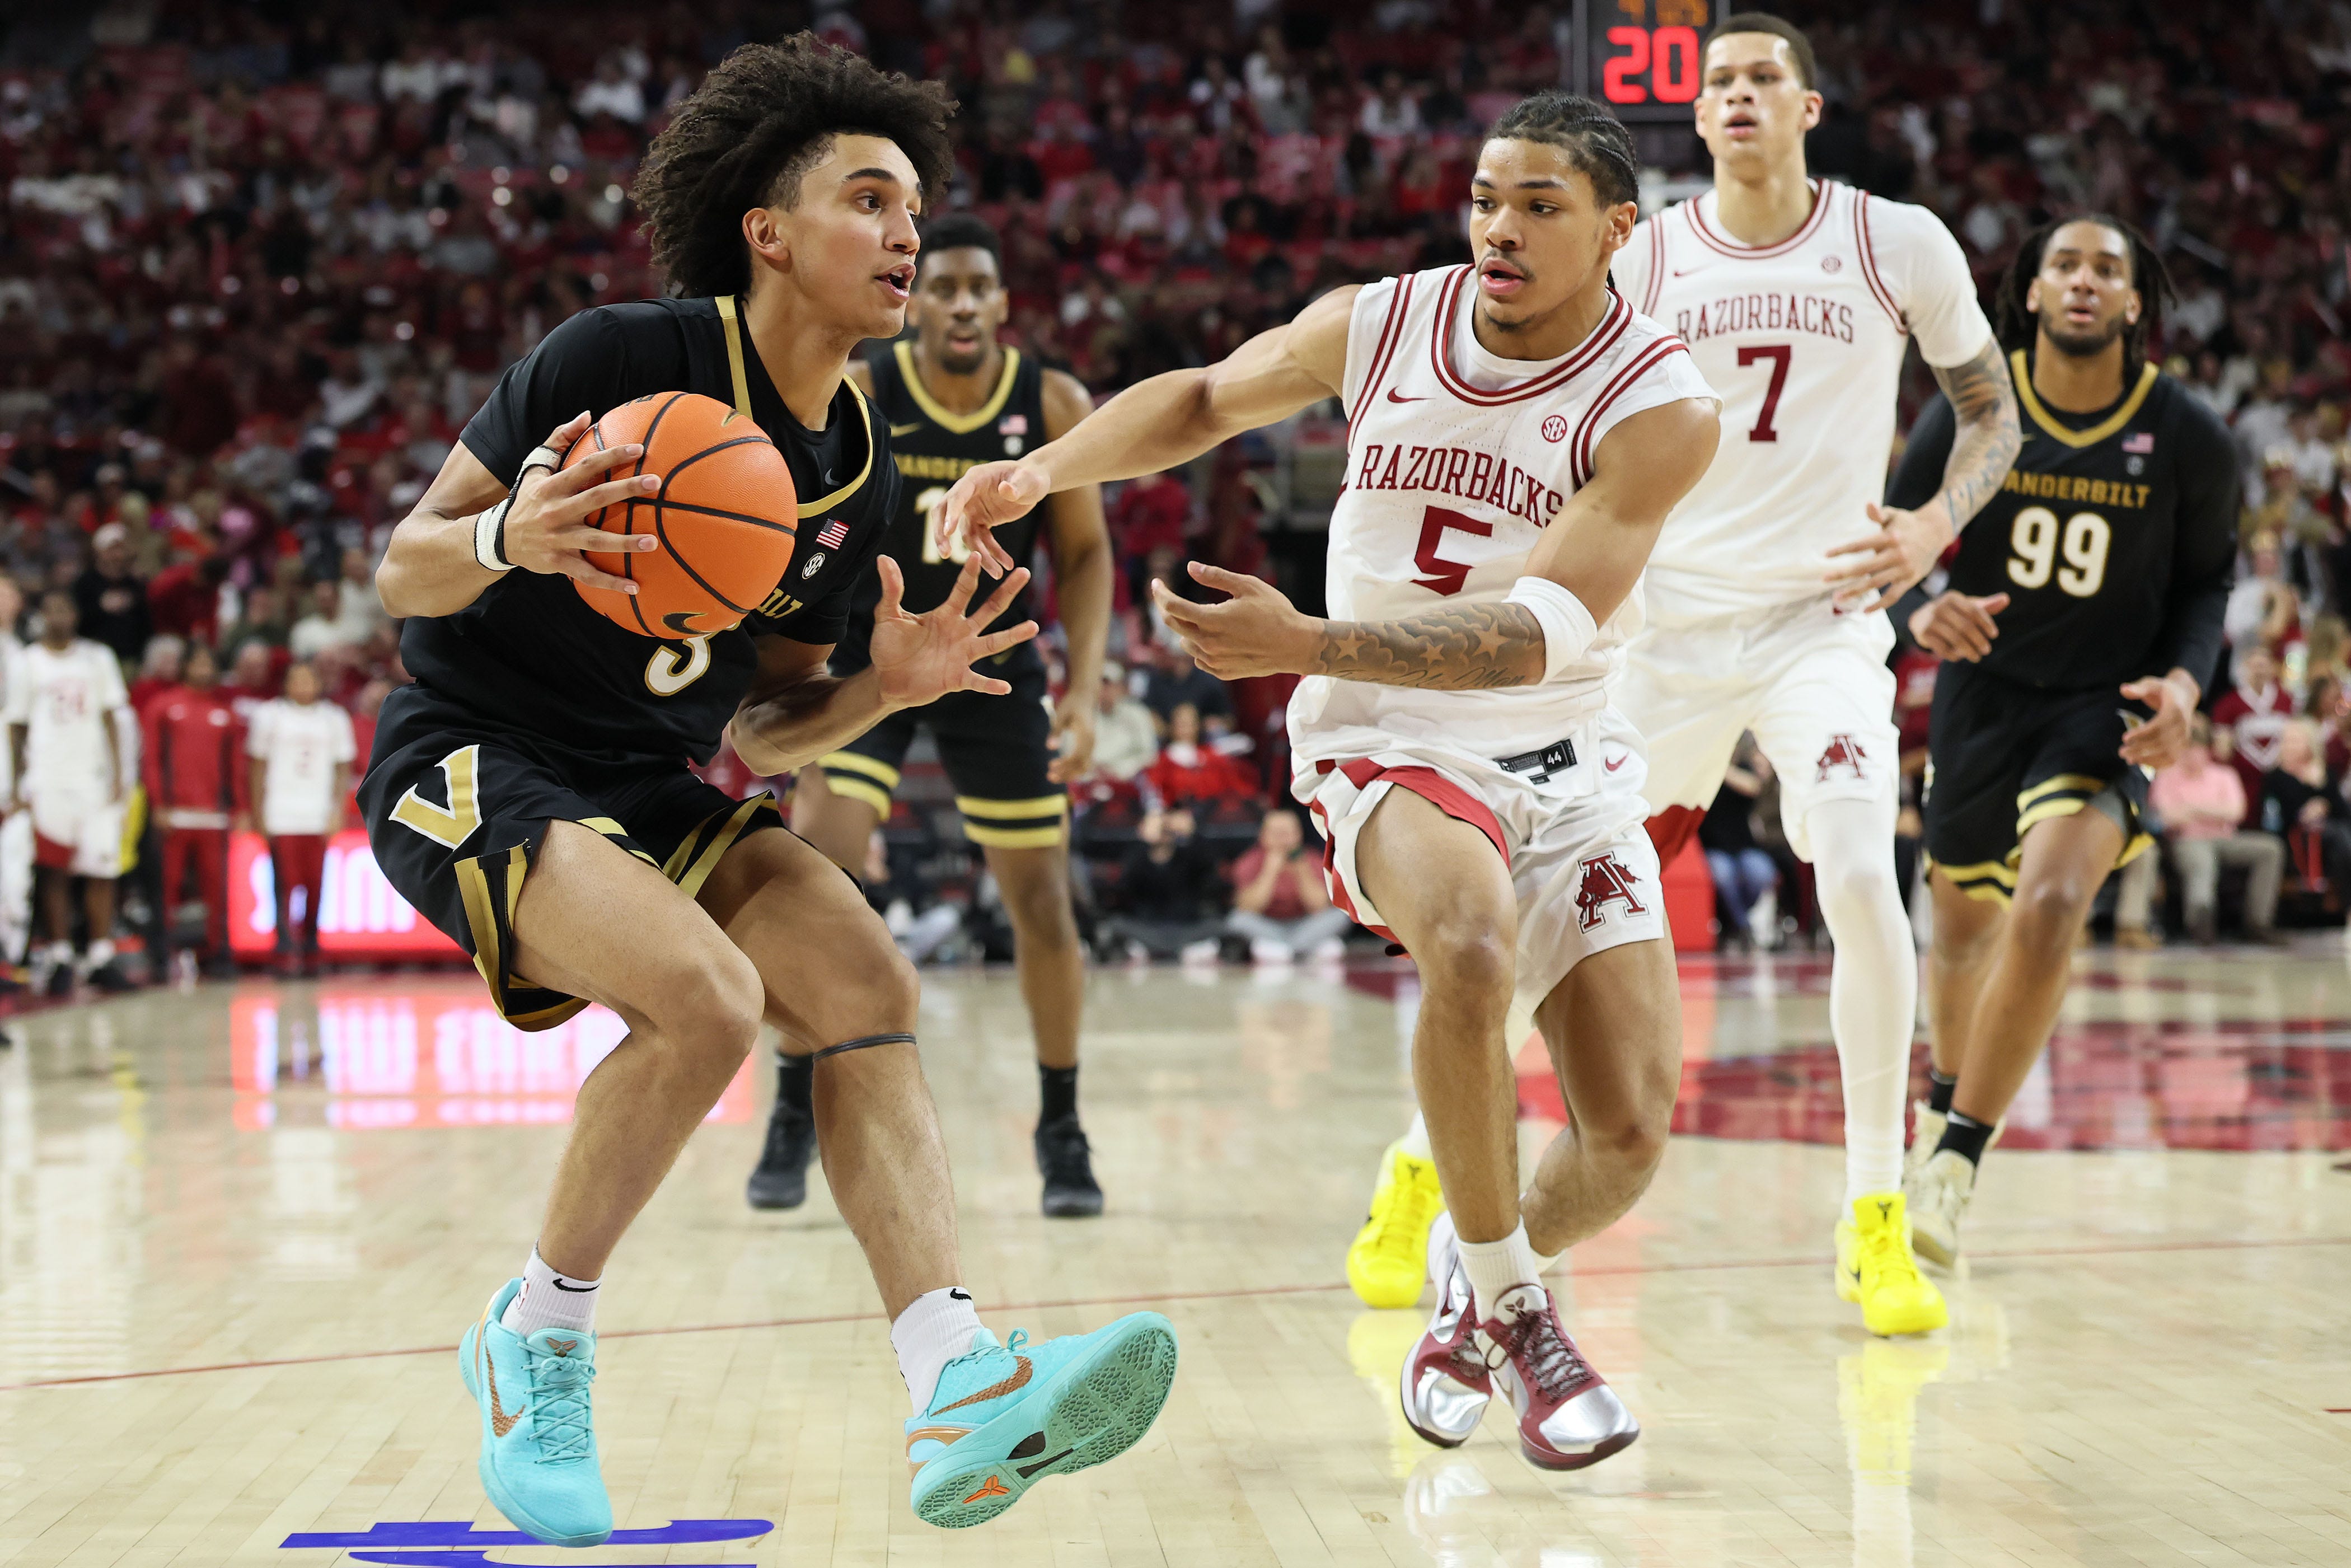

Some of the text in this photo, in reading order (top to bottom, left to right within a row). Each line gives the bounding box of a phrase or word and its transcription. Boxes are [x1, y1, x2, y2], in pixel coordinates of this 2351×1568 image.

[1603, 26, 1699, 104] 20
[1677, 293, 1853, 344] RAZORBACKS
[1738, 344, 1792, 442] 7
[1543, 416, 1566, 441] SEC
[1356, 444, 1563, 529] RAZORBACKS
[2003, 469, 2152, 509] ANDERBILT
[804, 554, 823, 577] SEC
[1409, 505, 1493, 596] 5
[2006, 505, 2113, 598] 99
[1547, 750, 1562, 765] 44
